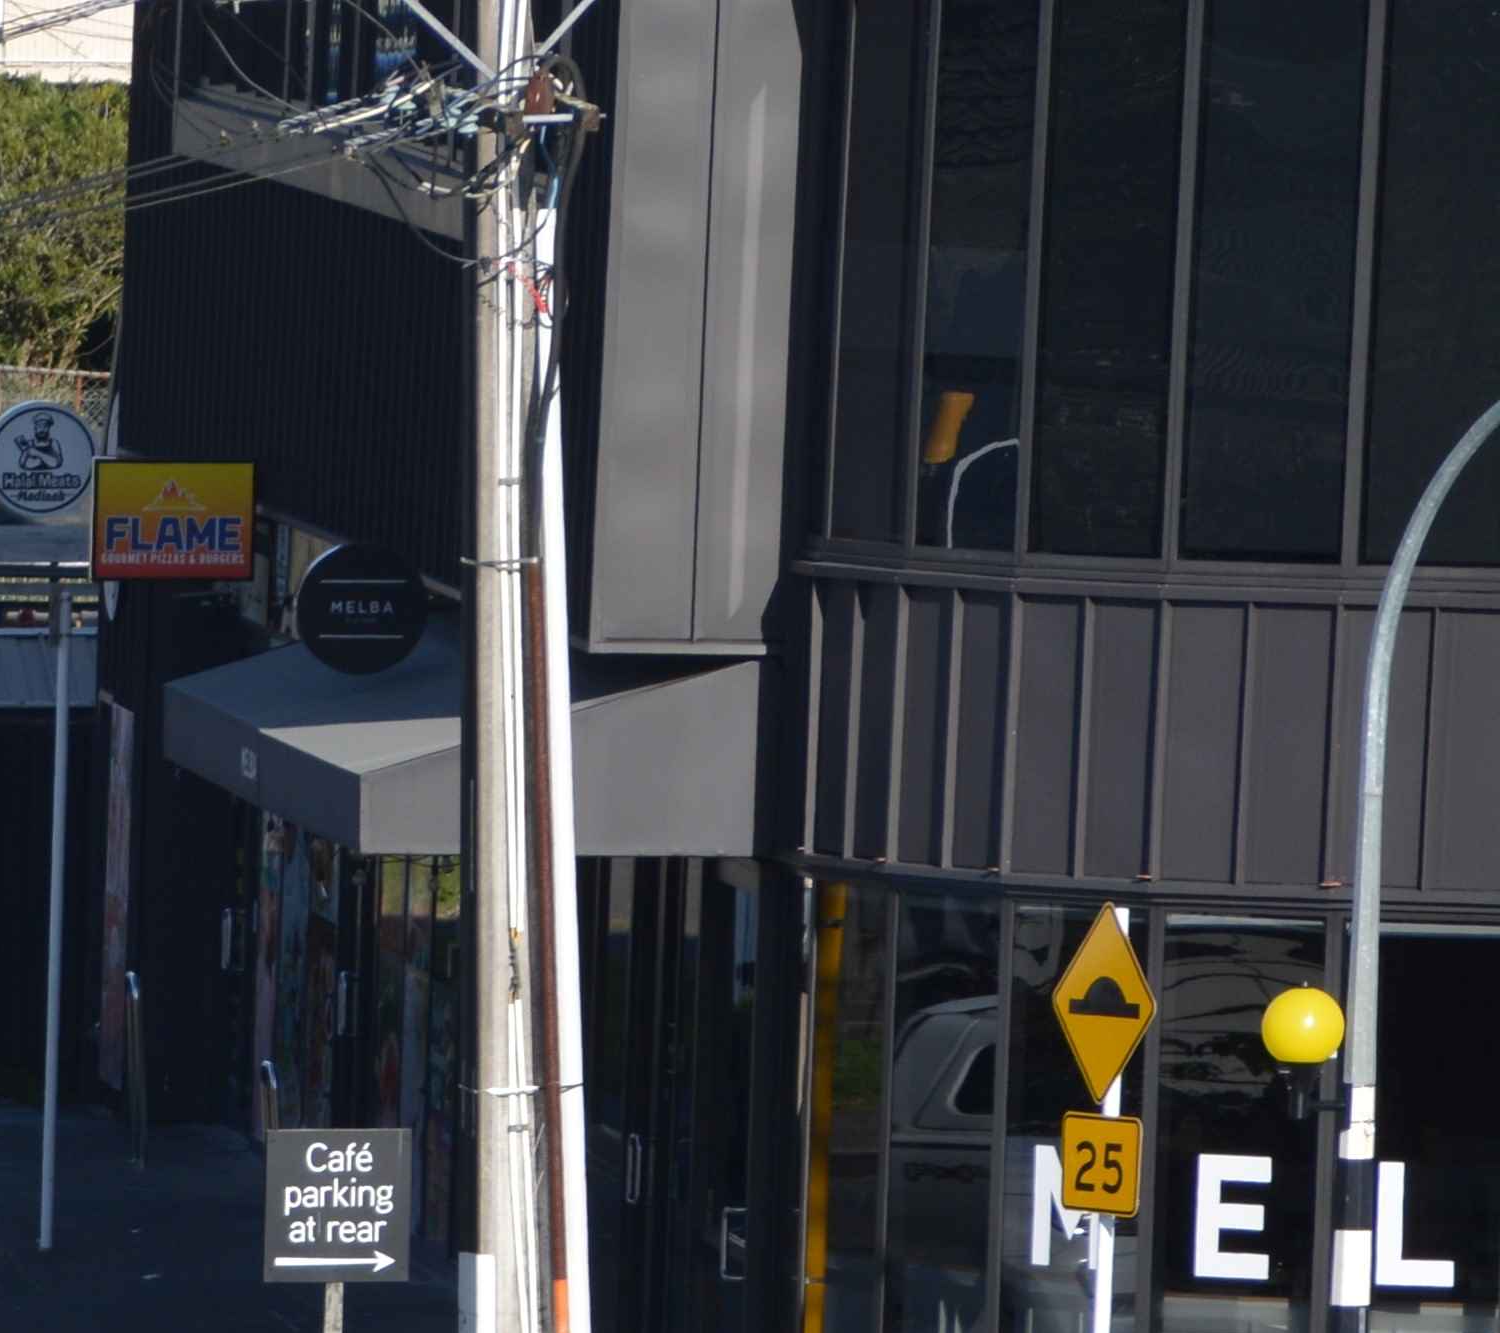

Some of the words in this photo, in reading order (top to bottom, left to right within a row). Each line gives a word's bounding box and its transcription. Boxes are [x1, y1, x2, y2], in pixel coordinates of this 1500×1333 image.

[106, 516, 242, 552] FLAME
[100, 552, 147, 564] GOURMET
[150, 552, 185, 564] PIZZAS
[199, 552, 245, 564] BURGERS
[331, 600, 395, 614] MELBA
[305, 1142, 374, 1173] Café
[1074, 1140, 1124, 1194] 25
[283, 1177, 395, 1216] parking
[288, 1215, 317, 1243] at
[326, 1220, 388, 1243] rear
